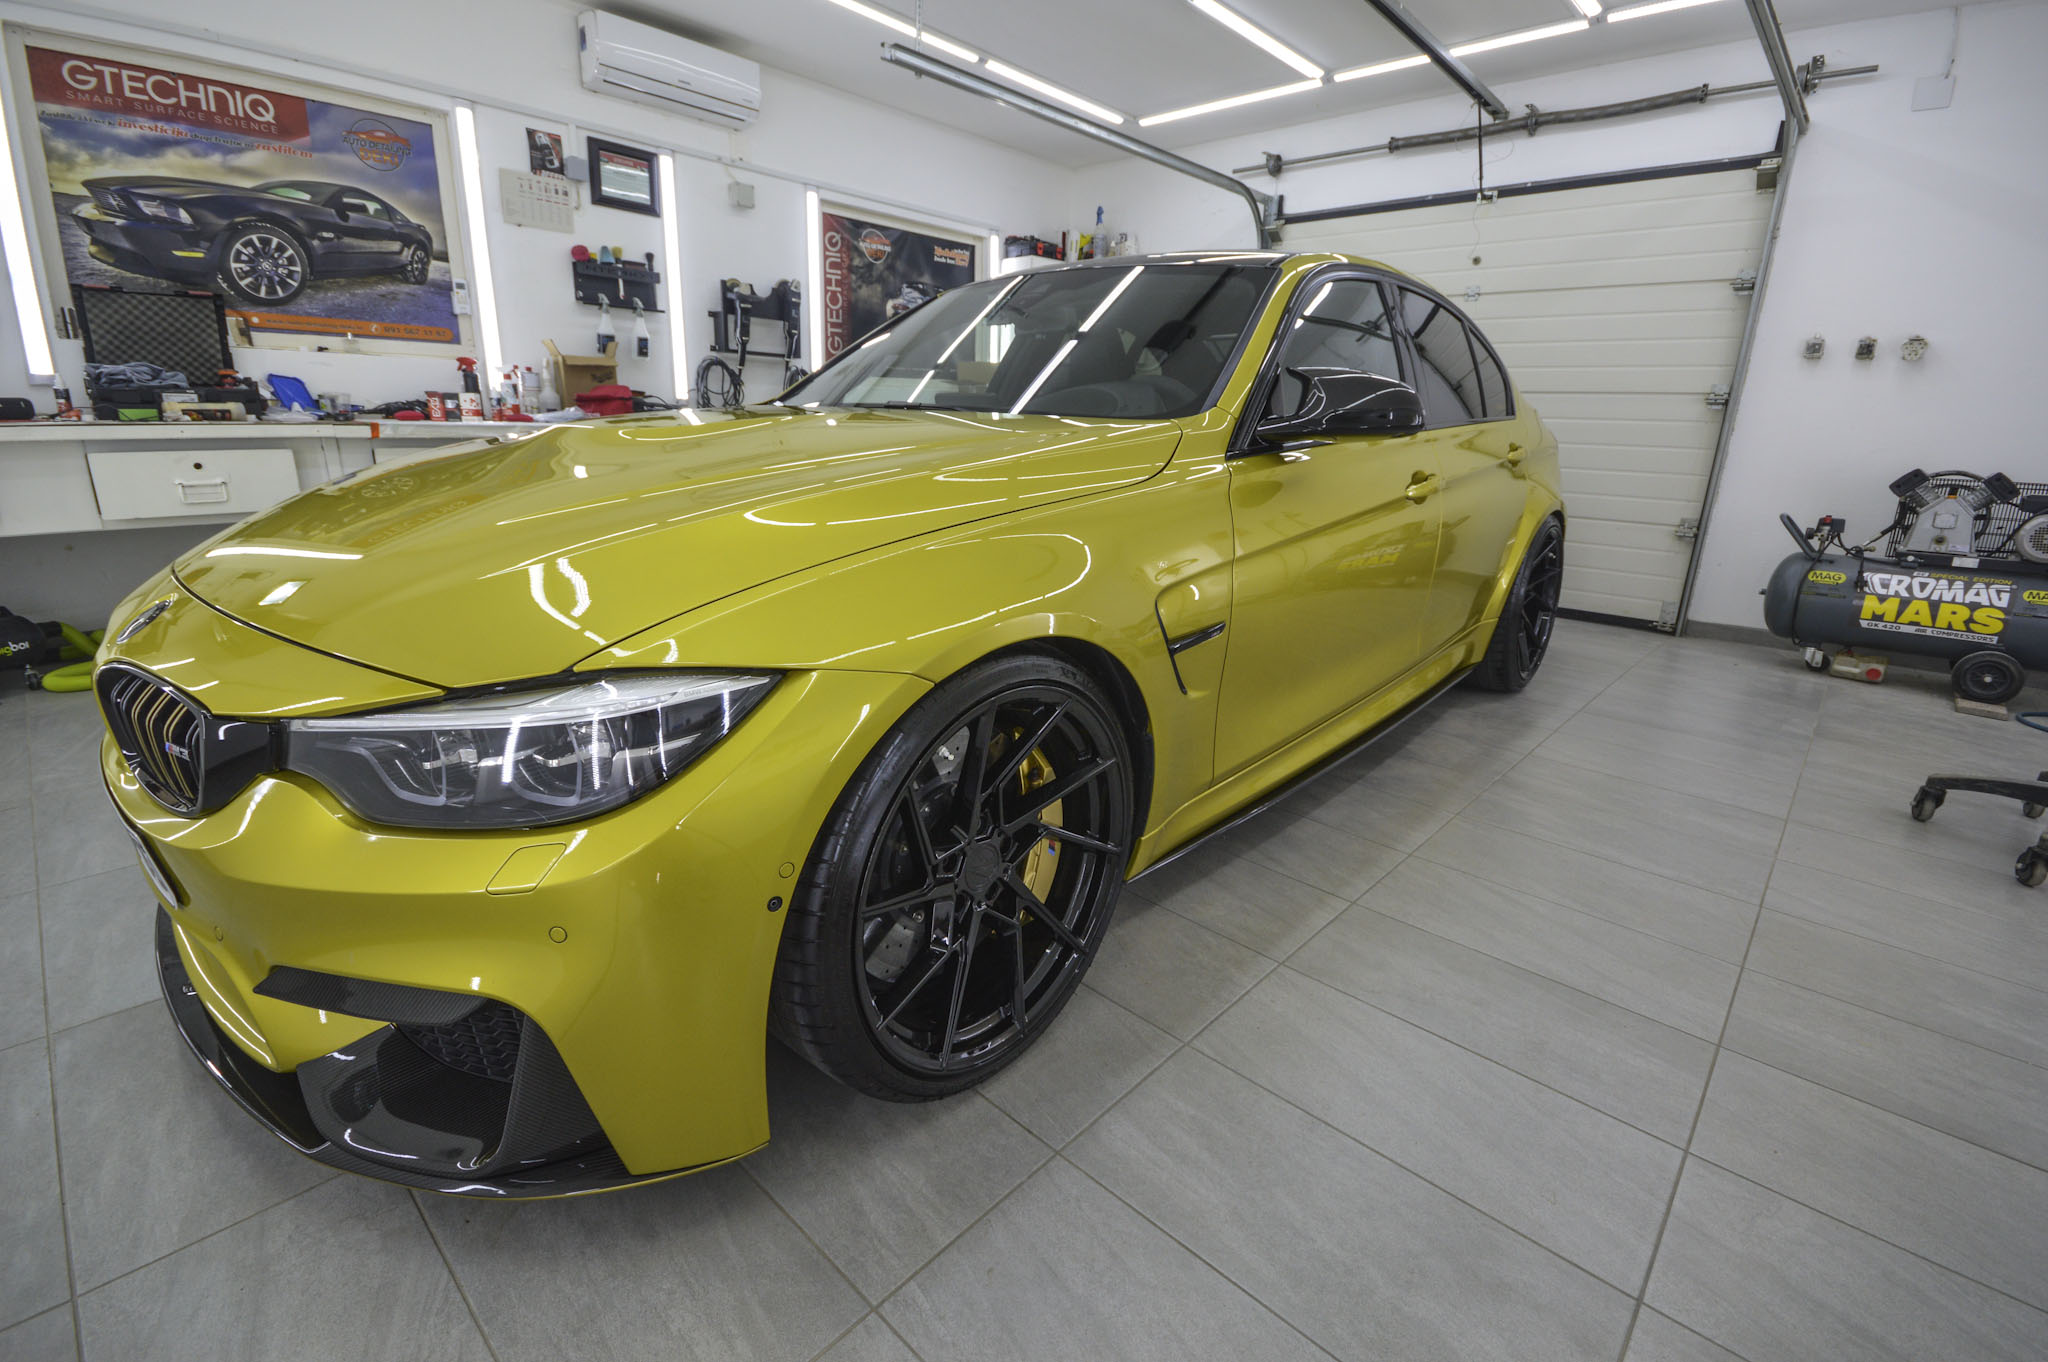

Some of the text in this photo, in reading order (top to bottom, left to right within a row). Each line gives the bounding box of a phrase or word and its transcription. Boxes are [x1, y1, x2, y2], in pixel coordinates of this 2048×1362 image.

[62, 60, 277, 124] GTECHNIQ
[65, 90, 124, 106] SMART
[134, 101, 205, 121] SURFACE
[214, 115, 278, 134] SCIENCE
[825, 231, 843, 355] GTECHNIQ
[1811, 571, 1842, 581] MAG
[1929, 572, 1970, 581] SPECIAL
[1972, 576, 2013, 585] EDITION
[2027, 591, 2048, 601] MA
[1861, 594, 2006, 635] MARS
[1882, 623, 1901, 631] 420
[1930, 629, 1995, 643] COMPRESSORS
